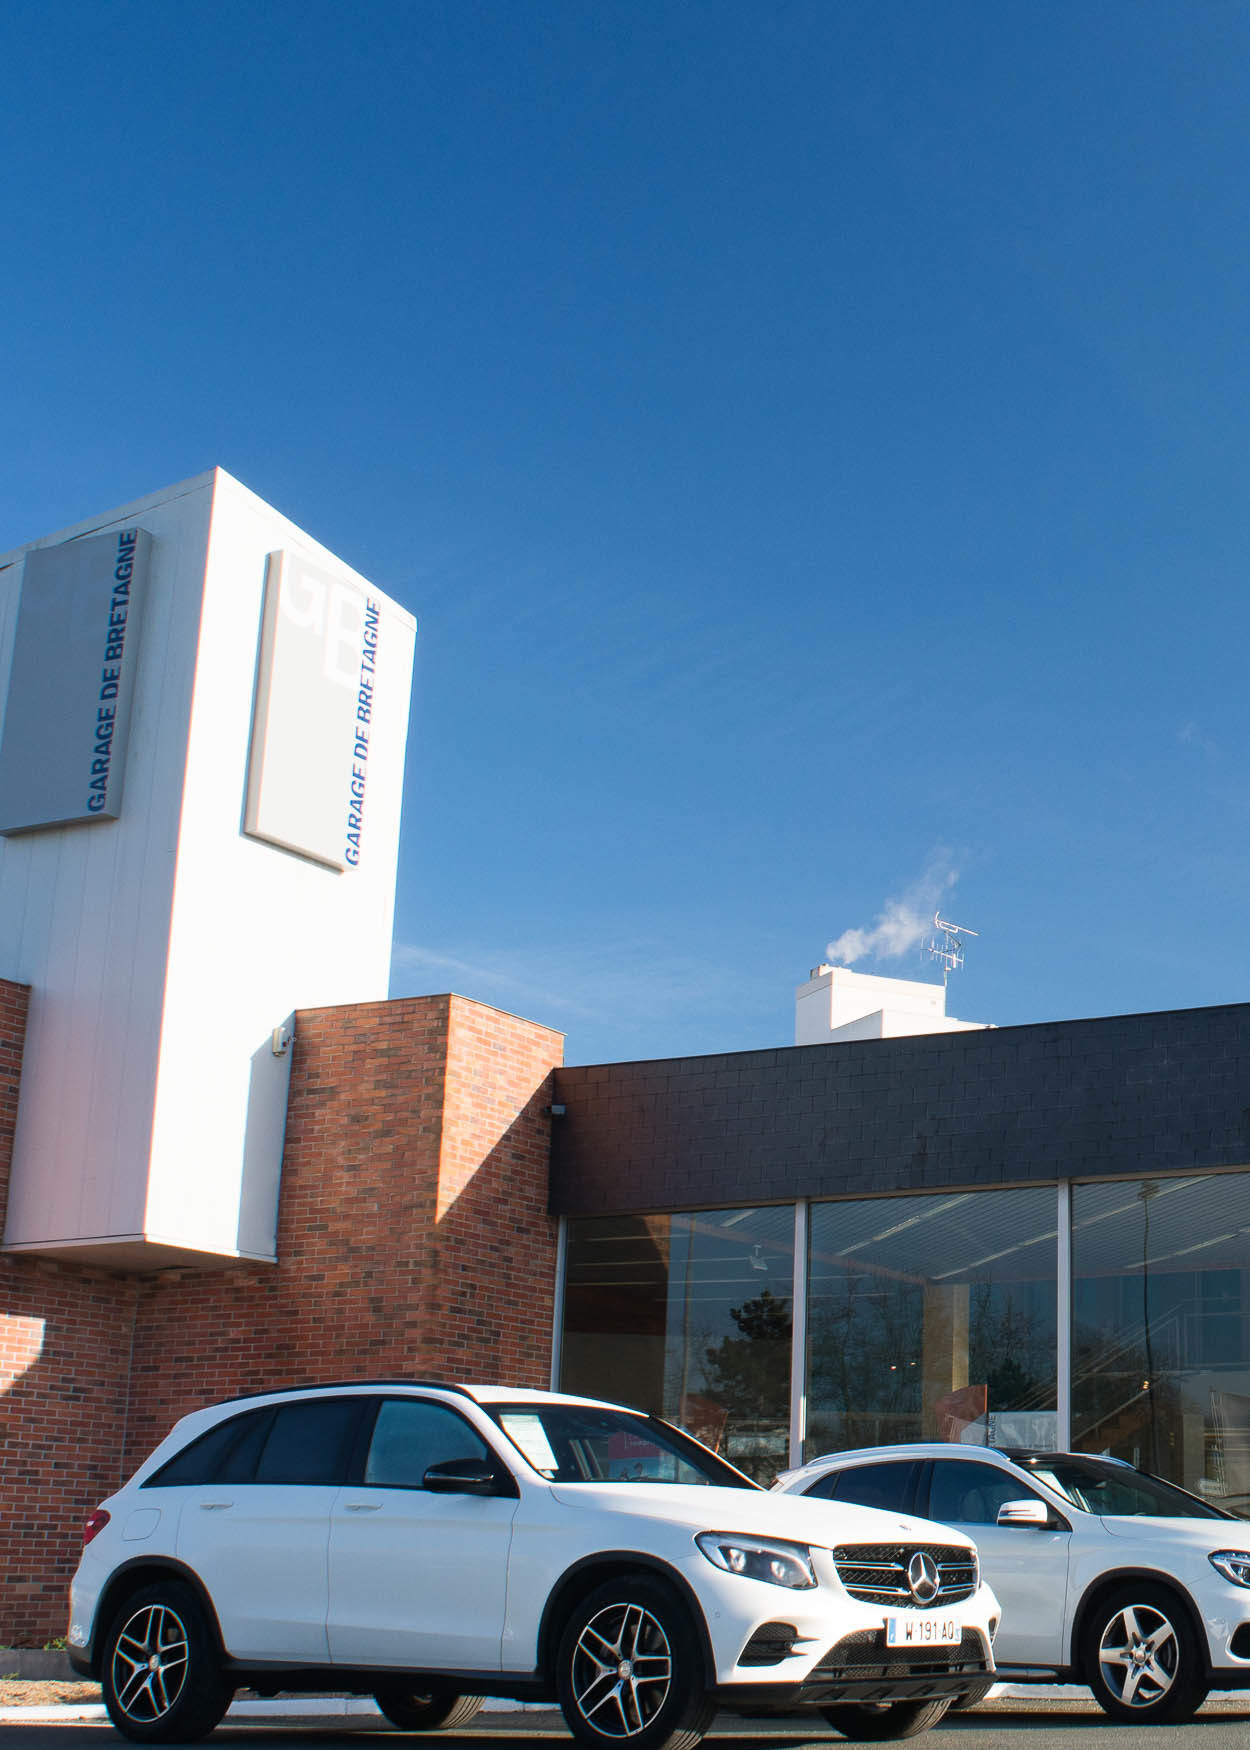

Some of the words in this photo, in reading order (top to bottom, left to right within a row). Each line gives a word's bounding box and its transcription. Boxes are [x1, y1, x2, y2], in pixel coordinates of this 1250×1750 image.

[104, 528, 138, 662] BRETAGNE
[100, 665, 121, 701] DE
[357, 597, 381, 724] BRETAGNE
[87, 704, 117, 812] GARAGE
[353, 726, 370, 761] DE
[345, 763, 367, 866] GARAGE
